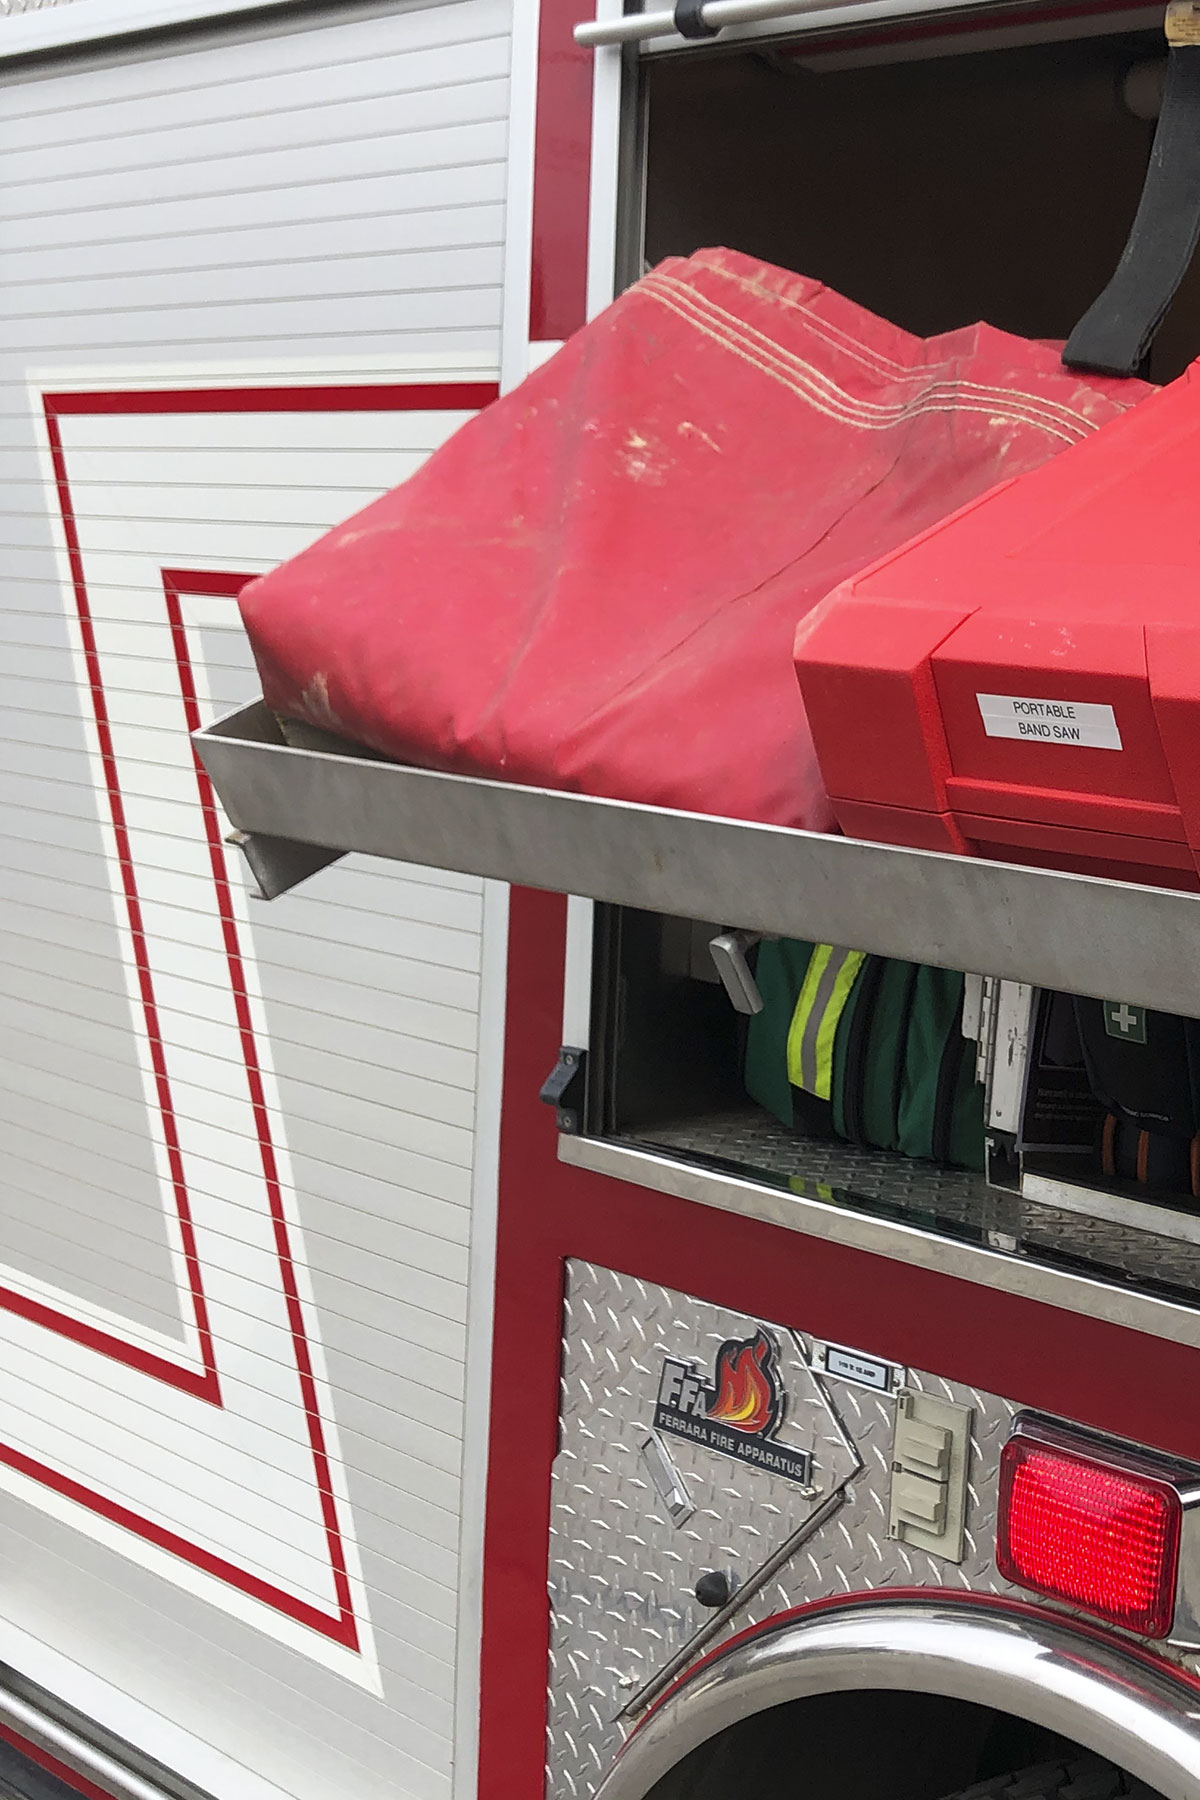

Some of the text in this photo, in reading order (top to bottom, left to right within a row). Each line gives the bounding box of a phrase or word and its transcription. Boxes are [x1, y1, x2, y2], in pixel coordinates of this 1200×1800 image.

[1013, 701, 1076, 719] PORTABLE
[1018, 722, 1081, 740] BAND SAW
[659, 1412, 803, 1477] FERRARA FIRE APPARATUS
